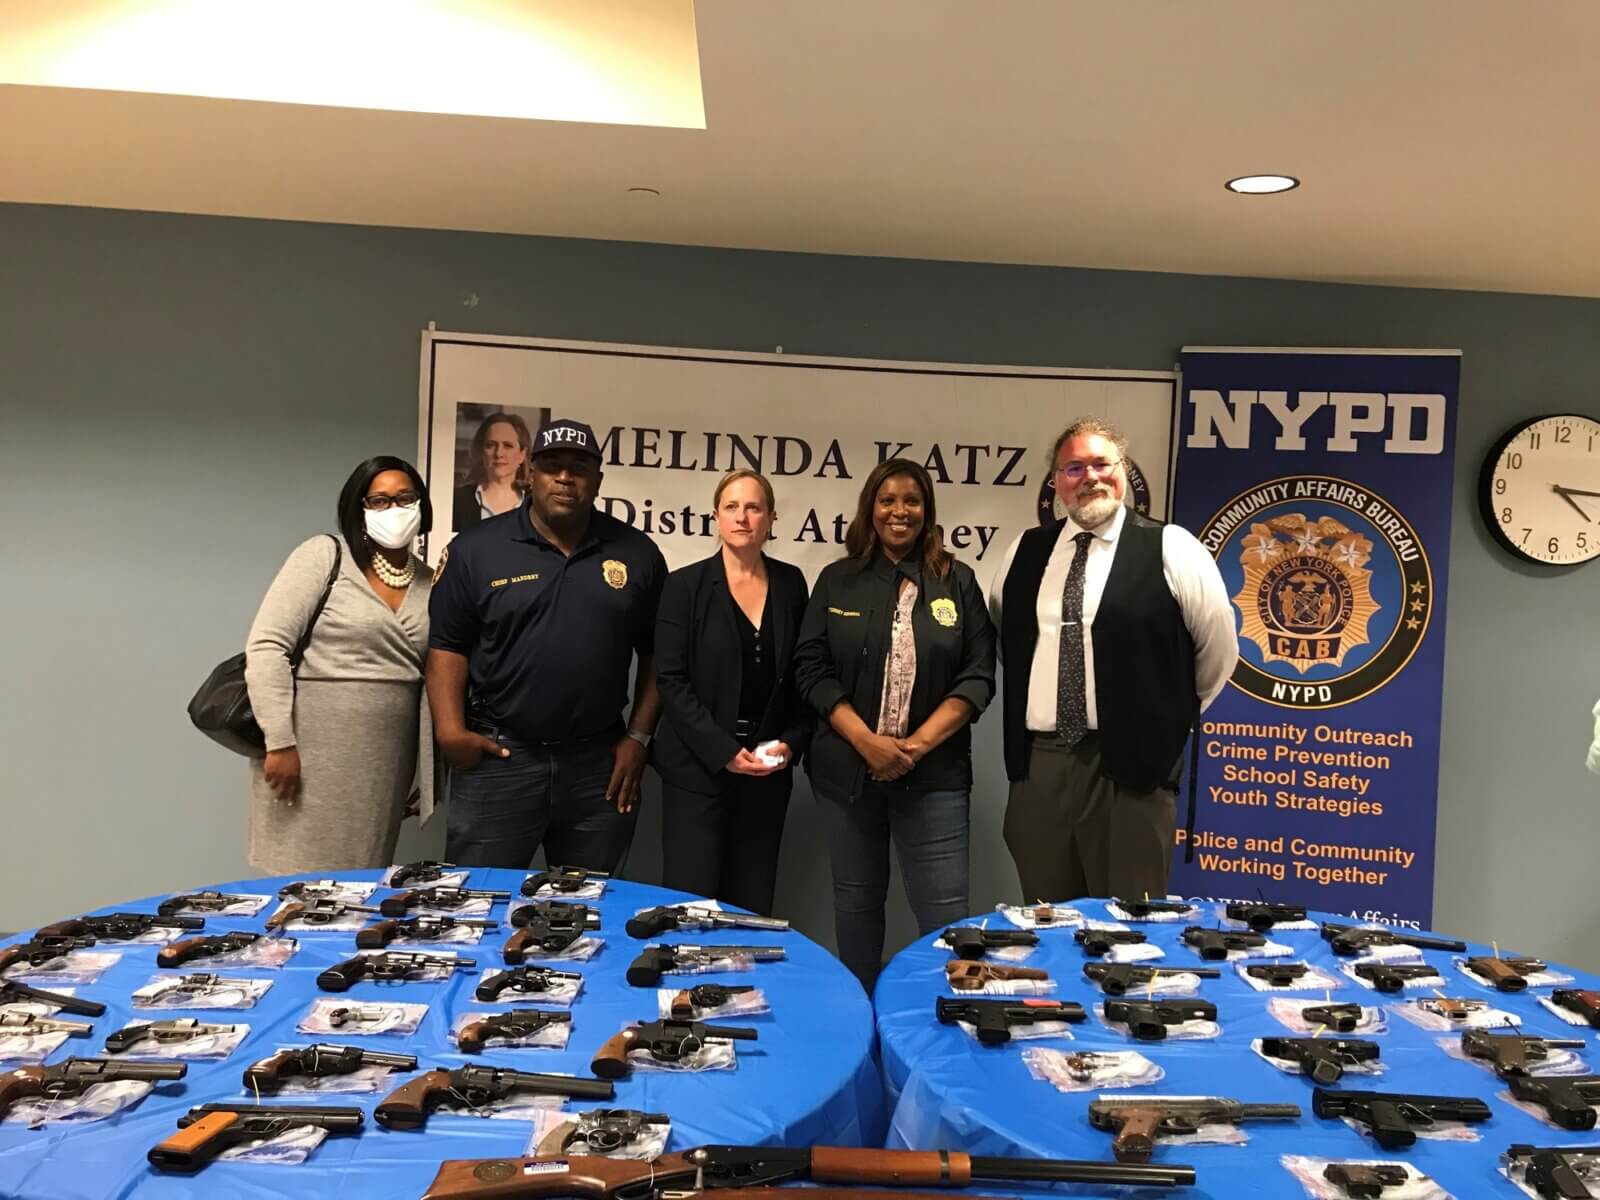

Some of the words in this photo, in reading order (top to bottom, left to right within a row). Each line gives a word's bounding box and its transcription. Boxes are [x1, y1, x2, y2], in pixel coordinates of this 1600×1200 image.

[1187, 389, 1447, 455] NYPD
[543, 426, 587, 447] NYPD
[1530, 432, 1541, 450] 11
[1554, 426, 1572, 444] 12
[1588, 435, 1593, 453] 1
[599, 426, 853, 479] MELINDA
[874, 441, 1028, 487] KATZ
[1506, 452, 1523, 470] 10
[1495, 478, 1507, 495] 9
[1202, 482, 1288, 552] COMMUNITY
[1294, 480, 1368, 509] AFFAIRS
[1365, 501, 1419, 562] BUREAU
[1501, 507, 1513, 524] 8
[601, 497, 778, 541] Distr
[793, 508, 1000, 561] Atey
[1521, 528, 1533, 544] 7
[1548, 537, 1559, 554] 6
[1576, 532, 1588, 549] 5
[1259, 597, 1273, 624] CITY
[1273, 558, 1301, 576] NEW
[1306, 557, 1341, 578] YORK
[1336, 579, 1353, 625] POLICE
[1276, 637, 1330, 659] CAB
[1271, 681, 1332, 703] NYPD
[1202, 721, 1308, 745] ommunity
[1314, 724, 1413, 748] Outreach
[1206, 741, 1268, 761] Crime
[1274, 744, 1390, 769] Prevention
[1223, 764, 1296, 786] School
[1303, 770, 1371, 795] Safety
[1208, 785, 1268, 807] Youth
[1274, 791, 1384, 817] Strategies
[1244, 836, 1284, 854] and
[1290, 837, 1415, 869] Community
[1199, 853, 1285, 881] Working
[1292, 861, 1388, 886] Together
